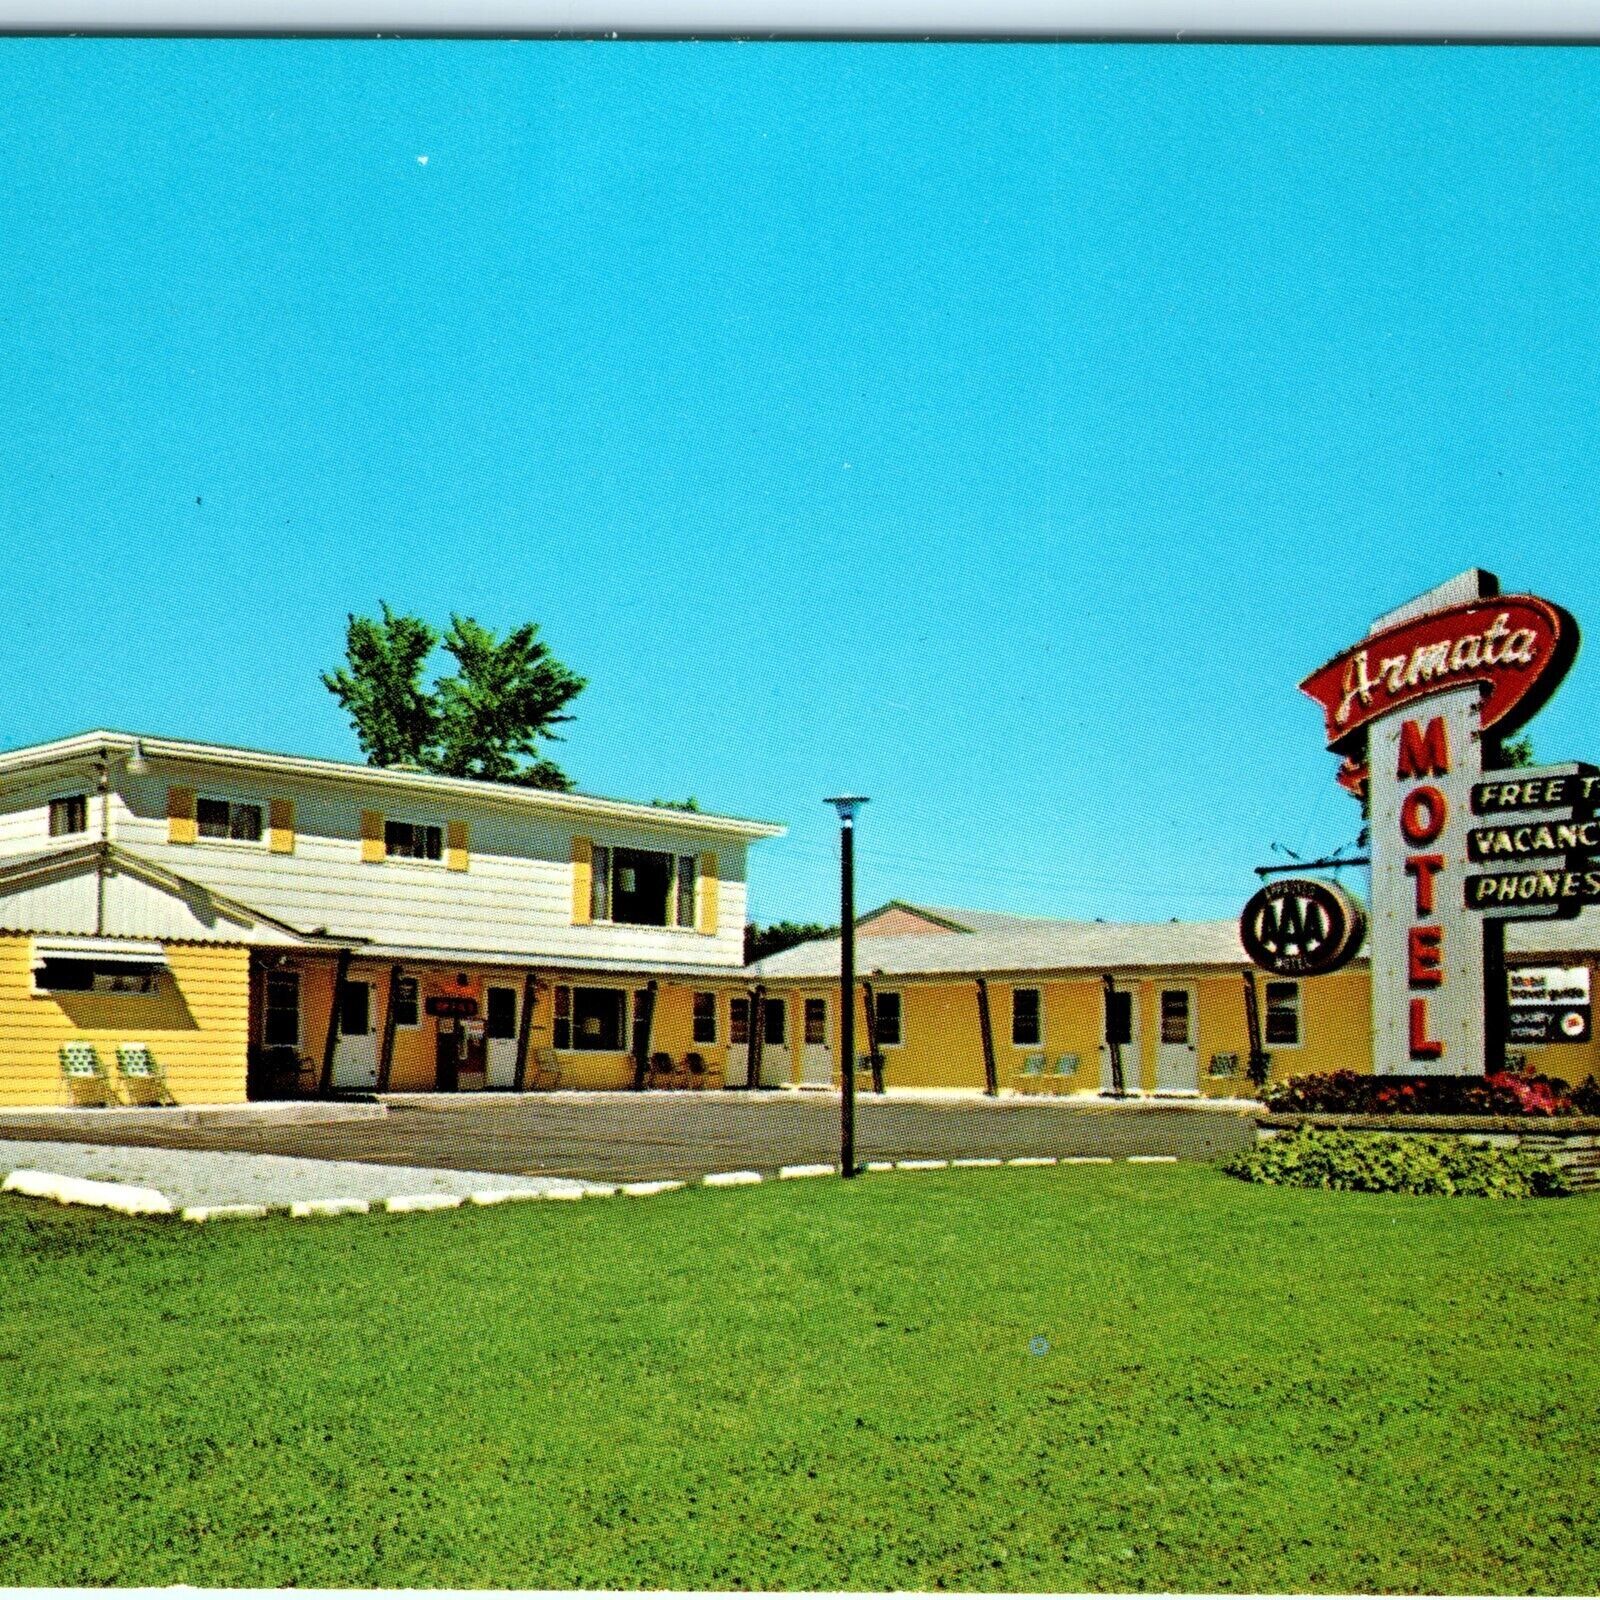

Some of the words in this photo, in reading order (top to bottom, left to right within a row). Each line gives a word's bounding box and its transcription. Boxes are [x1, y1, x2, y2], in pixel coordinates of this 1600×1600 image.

[1334, 611, 1538, 724] Armata
[1479, 780, 1566, 806] FREE
[1580, 775, 1600, 799] T
[1475, 821, 1600, 854] VACANC
[1396, 715, 1452, 1060] MOTEL
[1476, 869, 1600, 901] PHONES
[1256, 896, 1329, 955] AAA
